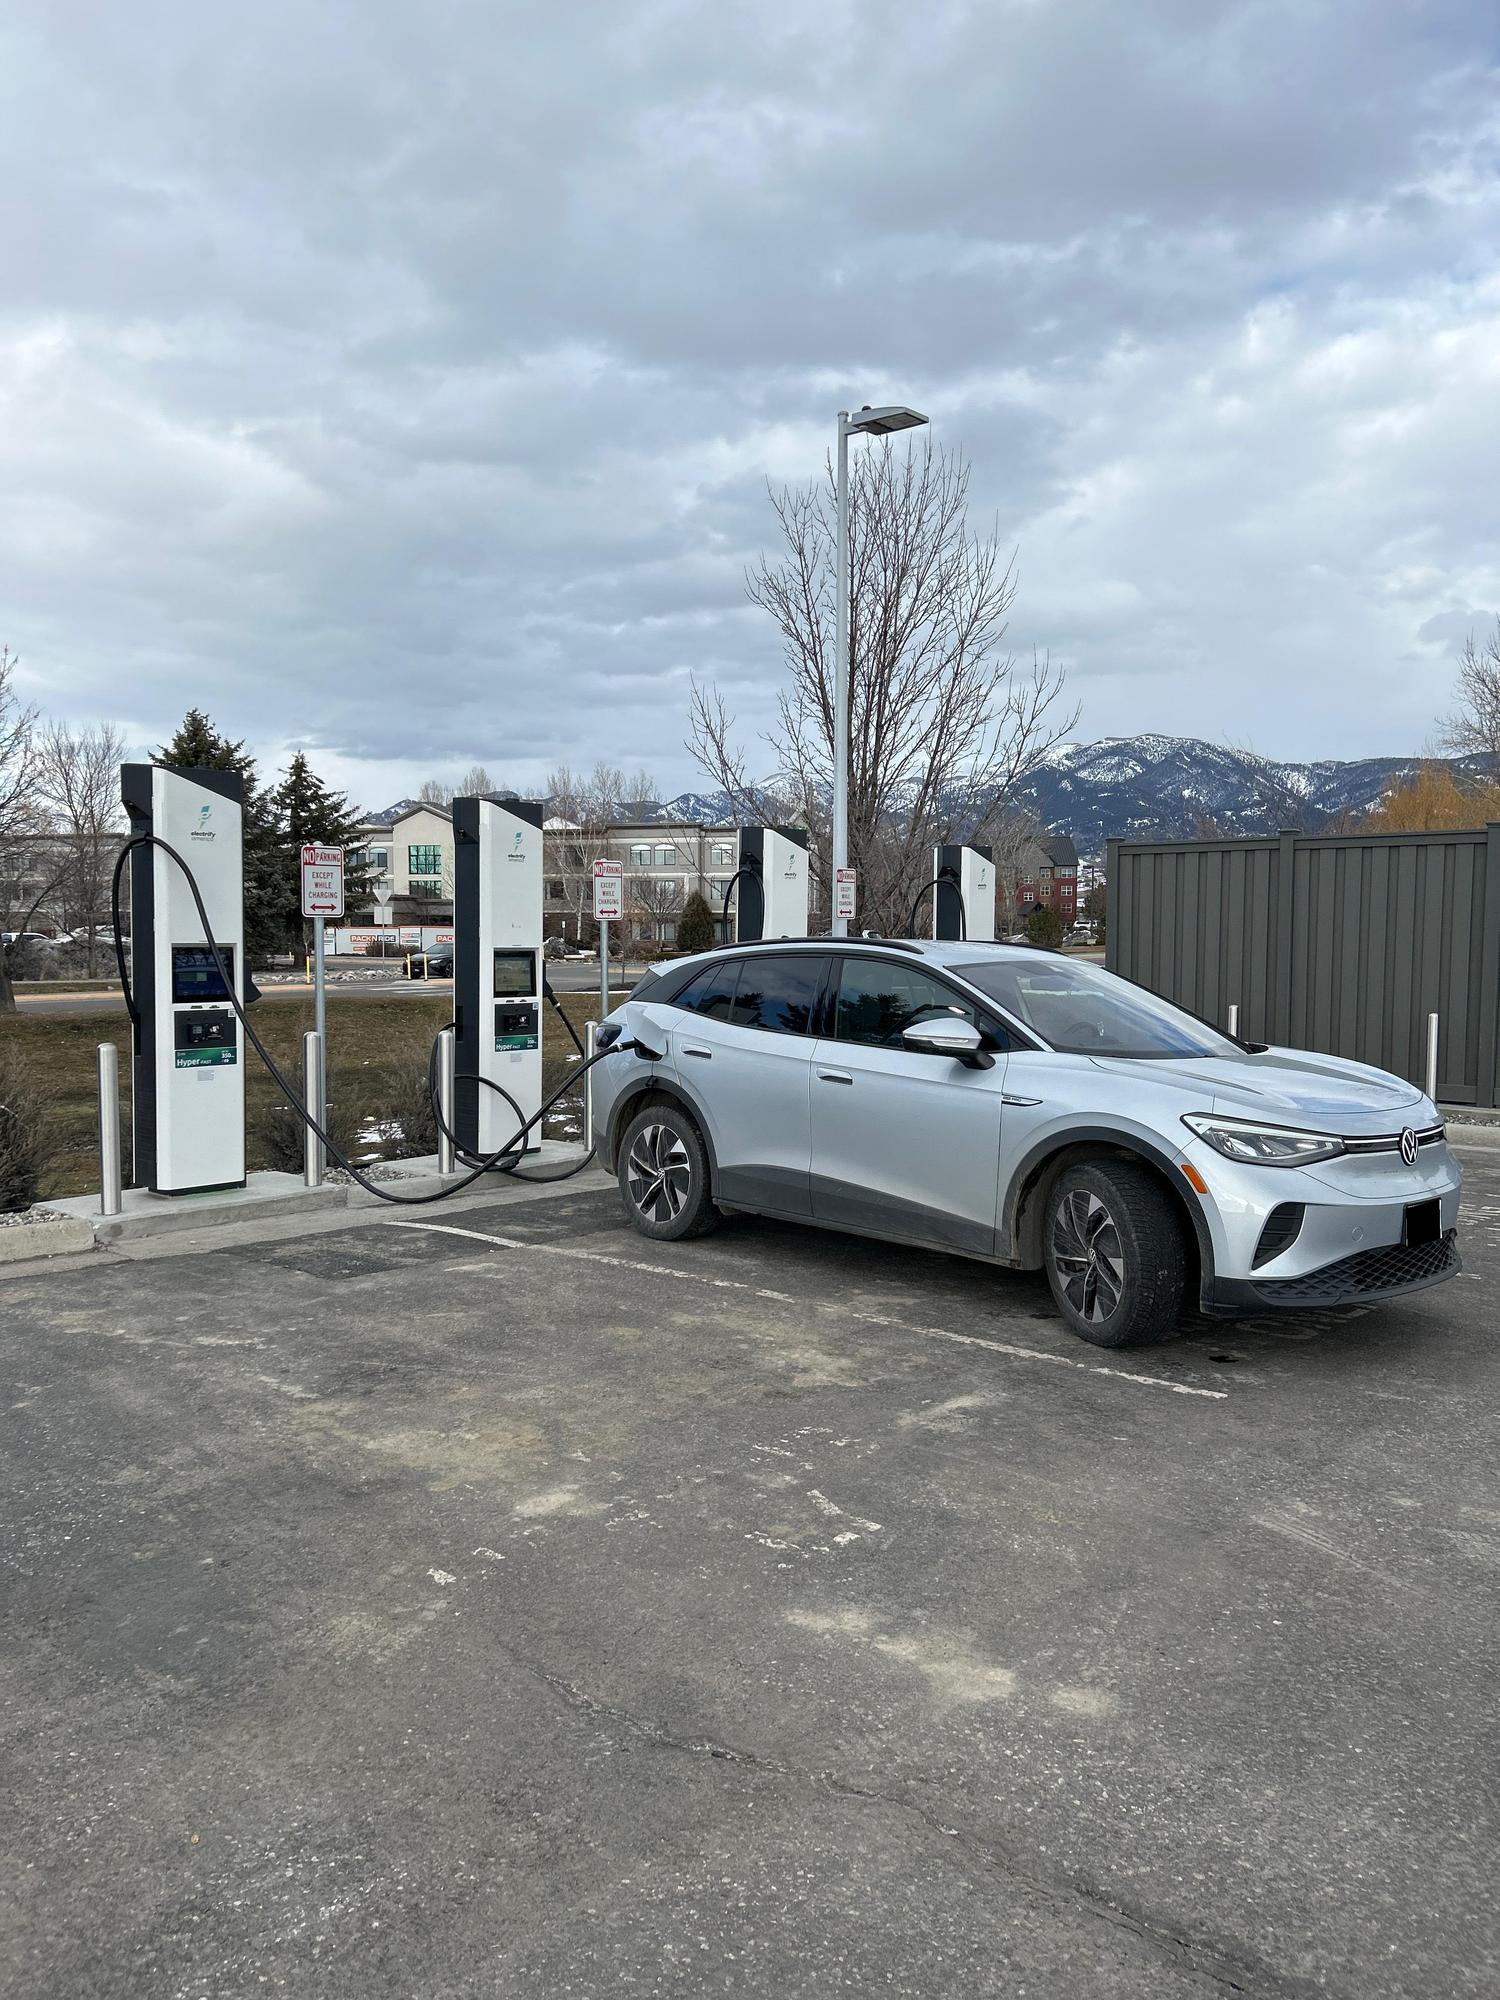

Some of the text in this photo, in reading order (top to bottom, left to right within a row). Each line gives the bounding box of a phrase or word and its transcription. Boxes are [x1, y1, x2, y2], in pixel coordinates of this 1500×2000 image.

[304, 850, 340, 863] NO PARKING
[595, 863, 621, 876] NO PARKING
[177, 1059, 200, 1067] Hyper
